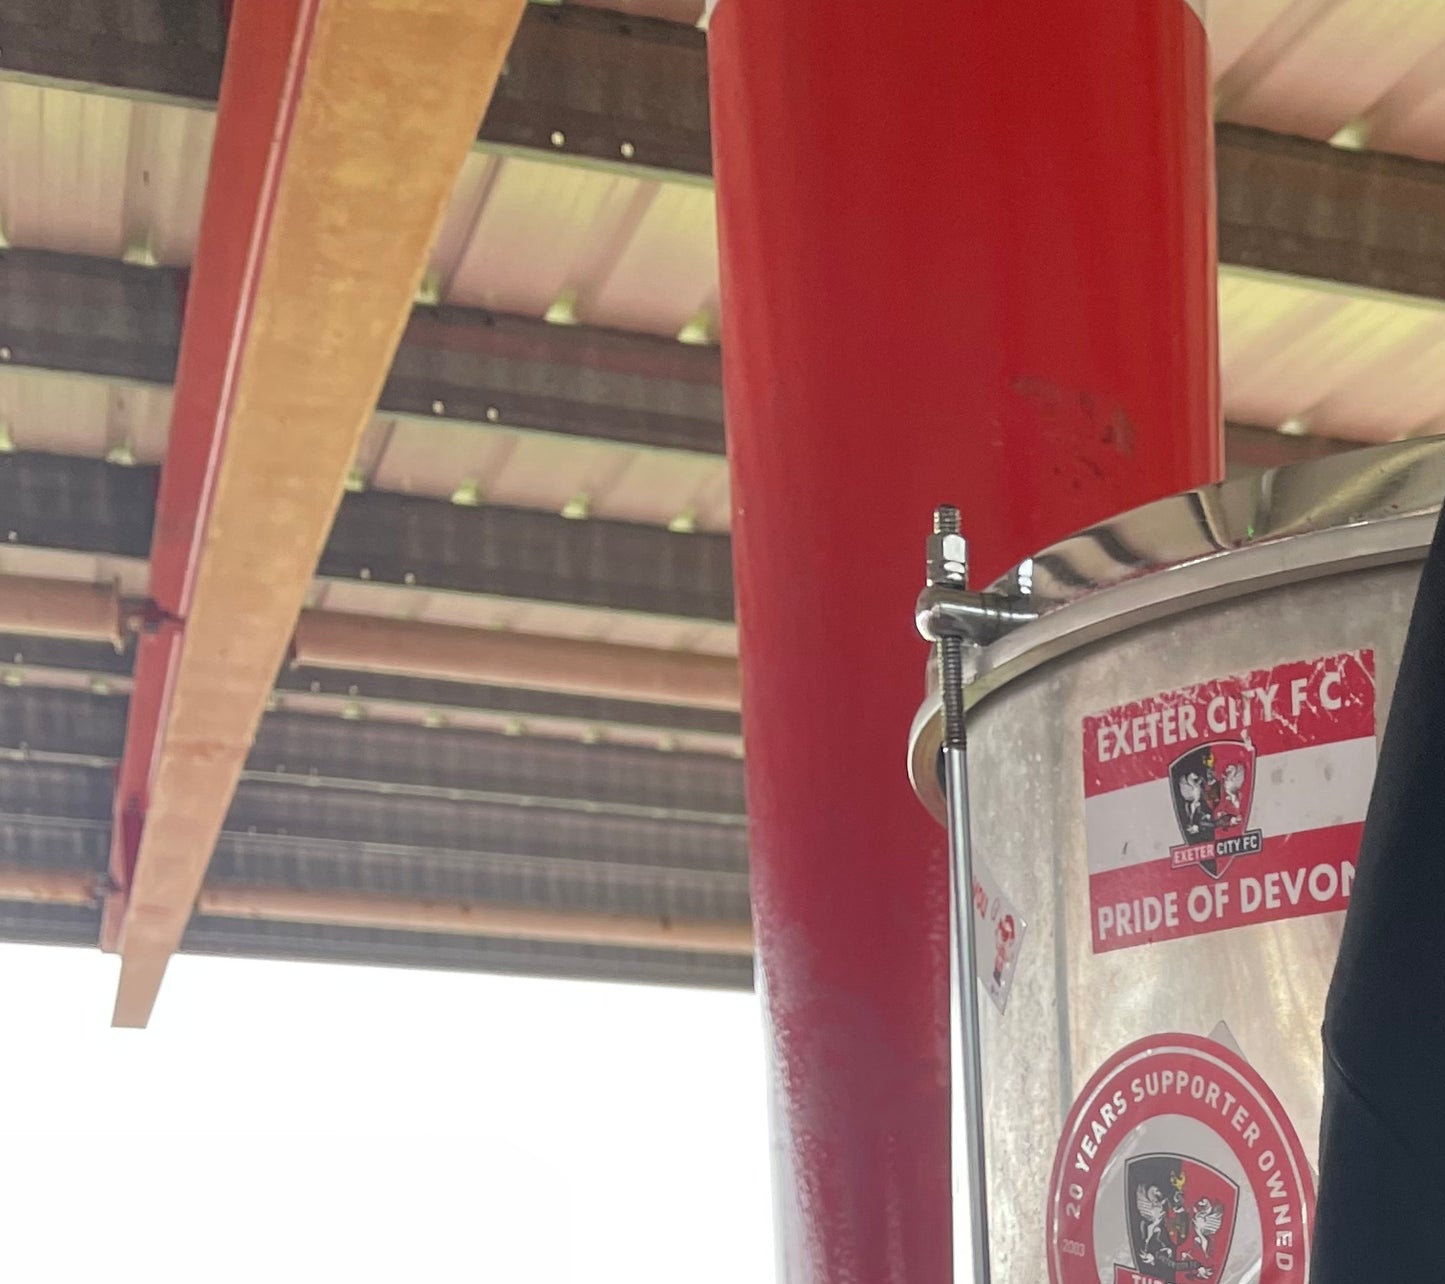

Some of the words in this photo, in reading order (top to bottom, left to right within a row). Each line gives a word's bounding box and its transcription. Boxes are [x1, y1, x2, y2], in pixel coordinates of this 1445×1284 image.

[1098, 704, 1198, 762] EXETER
[1207, 684, 1280, 734] CITY
[1173, 843, 1215, 865] EXETER
[1217, 838, 1242, 856] CITY
[1243, 835, 1258, 850] FC
[1098, 891, 1180, 941] PRIDE
[1187, 881, 1230, 922] OF
[1065, 1183, 1084, 1220] 20
[1075, 1090, 1128, 1173] YEARS
[1131, 1070, 1261, 1148] SUPPORTER
[1258, 1150, 1294, 1272] OWNED
